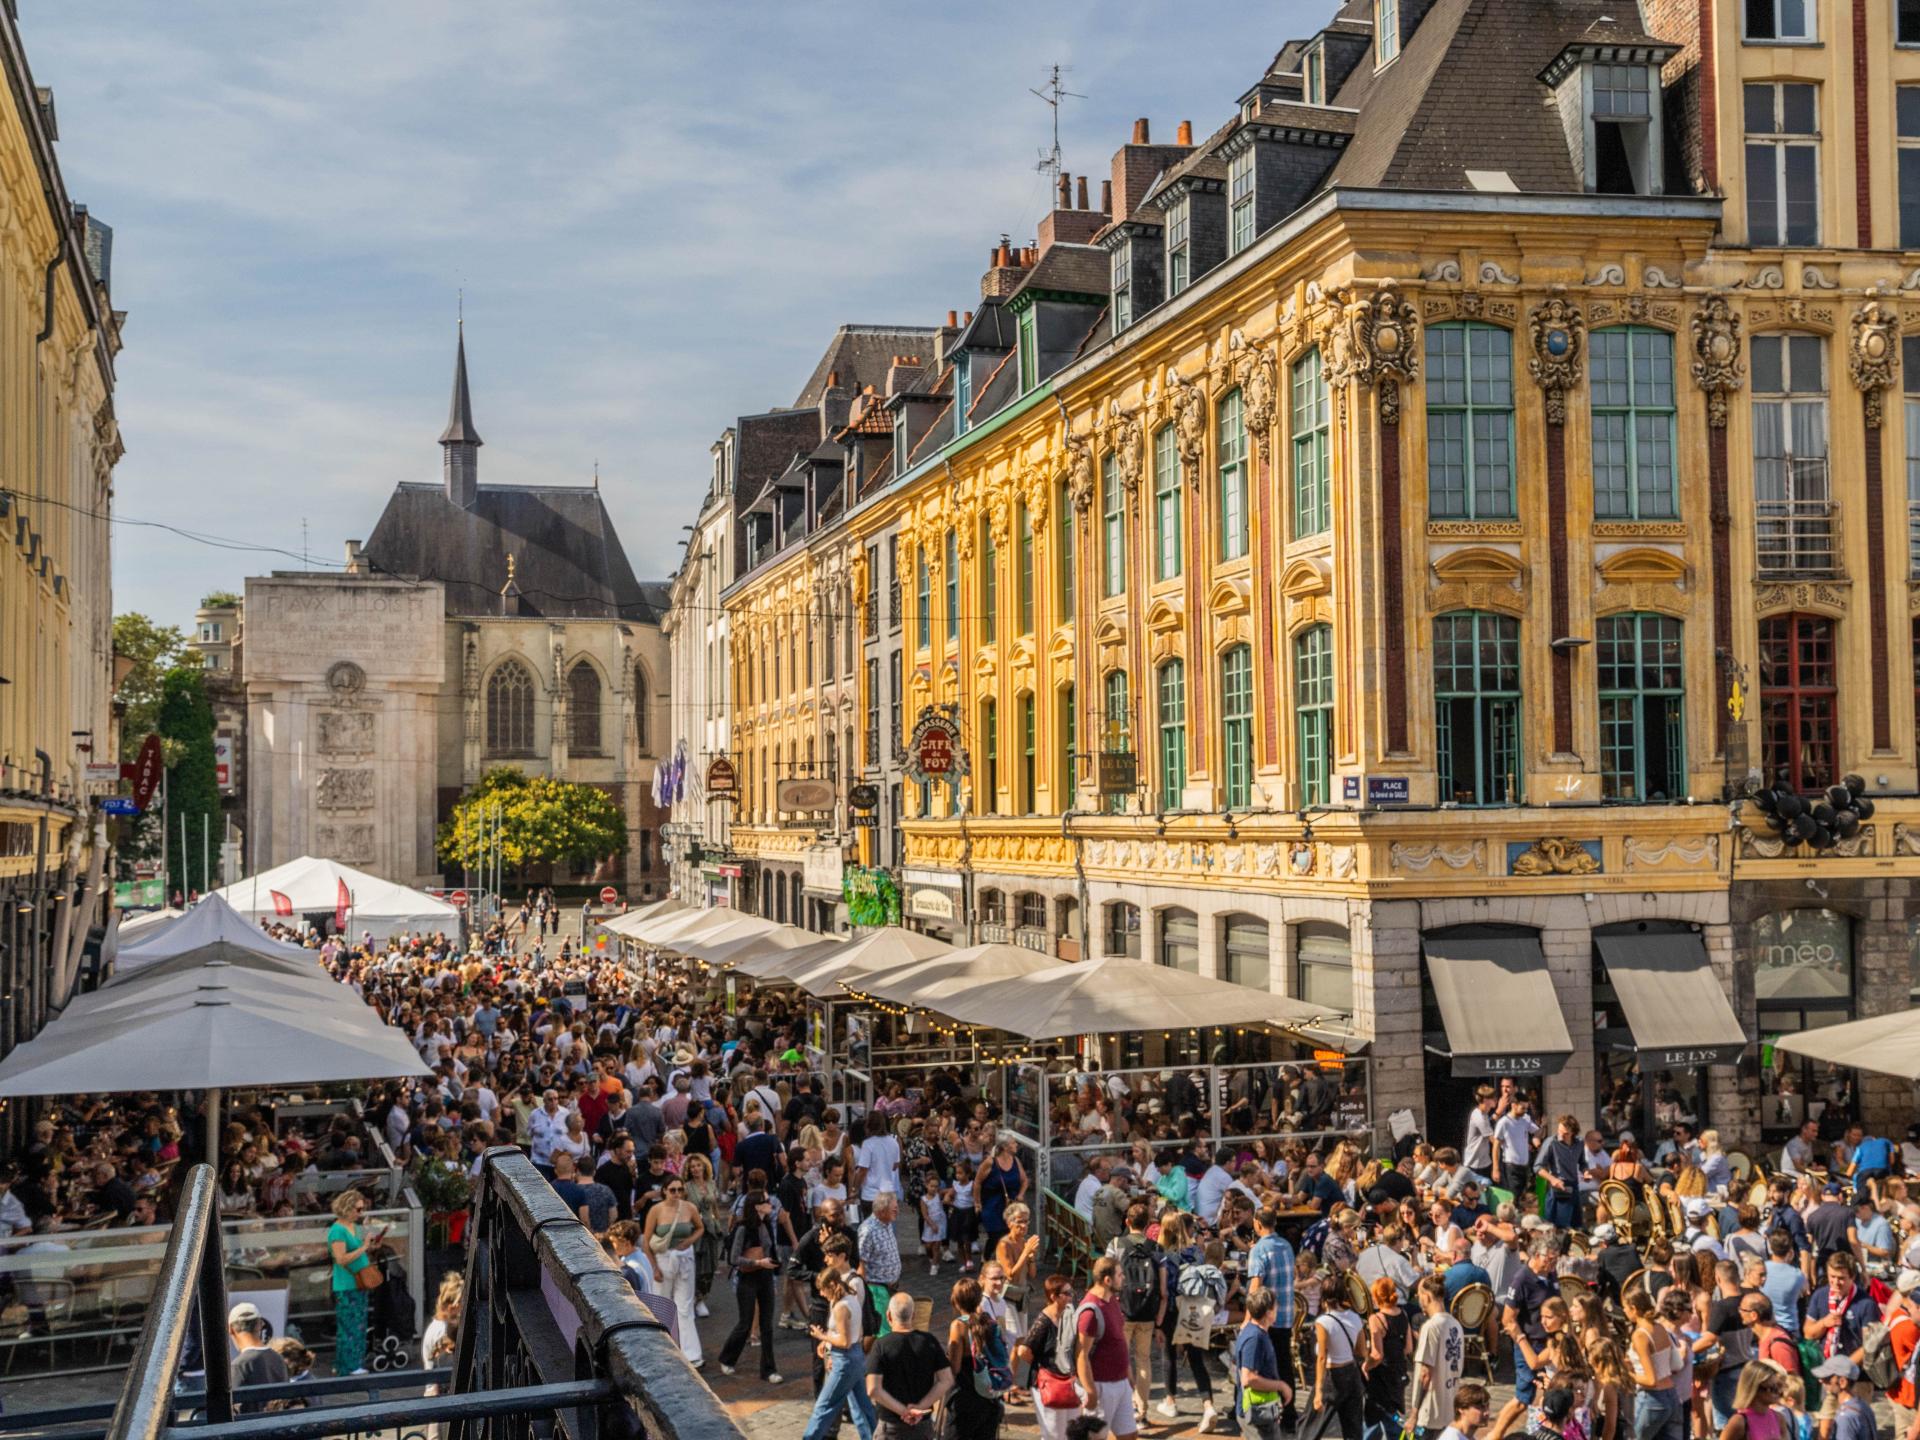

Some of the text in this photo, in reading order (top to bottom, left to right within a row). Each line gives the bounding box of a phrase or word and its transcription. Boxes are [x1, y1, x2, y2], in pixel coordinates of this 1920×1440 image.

[915, 718, 957, 738] BRASSERIE
[924, 758, 949, 769] FOY
[1101, 758, 1135, 769] LE LYS
[139, 749, 154, 795] TABAC
[854, 817, 877, 825] BAR
[1029, 933, 1046, 951] FOY
[1665, 1051, 1685, 1063] LE
[1688, 1049, 1718, 1061] LYS
[1485, 1057, 1541, 1070] LE LYS
[1340, 1102, 1357, 1111] Salle
